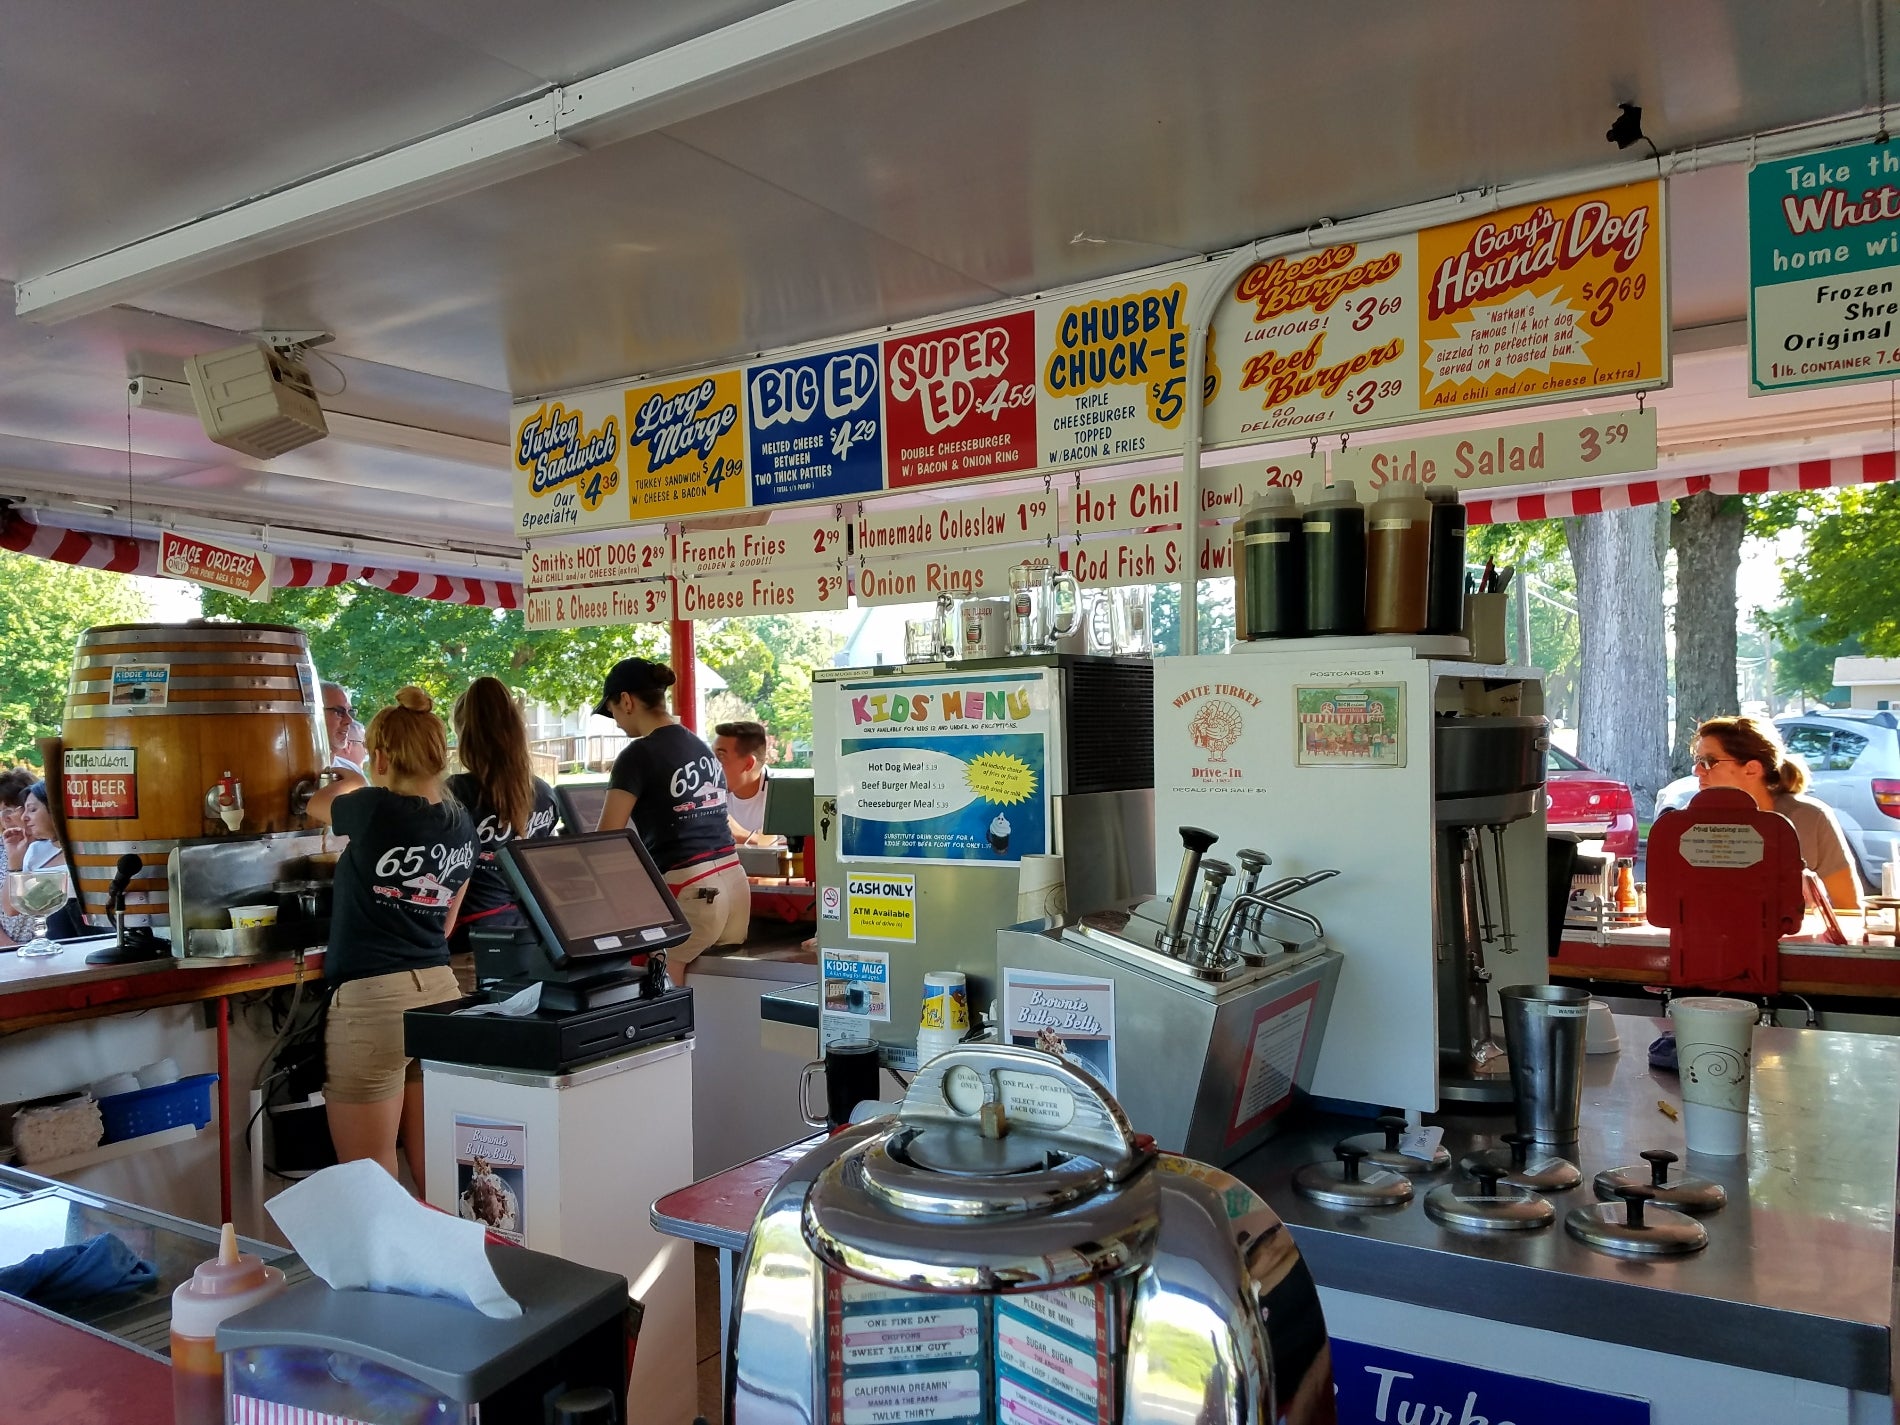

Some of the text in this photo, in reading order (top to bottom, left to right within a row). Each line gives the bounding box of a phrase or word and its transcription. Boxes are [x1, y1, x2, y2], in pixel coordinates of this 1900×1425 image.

[1786, 163, 1850, 191] Take
[1783, 189, 1900, 234] Whit
[1473, 208, 1553, 258] Gary's
[1433, 202, 1649, 315] Hound Dog
[1774, 246, 1849, 271] home
[1238, 244, 1356, 300] Cheese
[1256, 253, 1401, 320] Burgers
[1817, 281, 1893, 303] Frozen
[1062, 290, 1180, 348] CHUBBY
[1844, 302, 1898, 321] Shre
[1244, 317, 1329, 343] LUCIOUS!
[1471, 314, 1573, 341] Famous 1/4 hot dog
[1784, 322, 1890, 351] Original
[1437, 334, 1548, 362] sizzled perfection
[890, 327, 1010, 401] SUPER
[1050, 333, 1185, 389] CHUCK-E
[1242, 333, 1325, 389] Beef
[1265, 339, 1402, 408] Burgers
[1440, 349, 1547, 376] served toasted
[1801, 356, 1870, 375] CONTAINER
[751, 353, 878, 430] BIG ED
[1434, 362, 1641, 405] Add chili and/or cheese (extra)
[634, 380, 715, 441] Large
[920, 380, 974, 434] ED
[1076, 393, 1109, 410] TRIPLE
[1054, 406, 1135, 430] CHEESEBURGER
[1241, 411, 1334, 432] DELICIOUS!
[521, 408, 578, 461] Turkey
[651, 405, 736, 467] Marge
[762, 435, 823, 455] MELTED CHEESE
[901, 434, 1011, 460] DOUBLE CHEESEBURGER
[1075, 427, 1112, 444] TOPPED
[1116, 438, 1145, 453] FRIES
[534, 423, 616, 488] Sandwich
[774, 453, 810, 468] BETWEEN
[918, 450, 1019, 475] BACON ONION RING
[1369, 451, 1437, 489] Side
[1454, 433, 1545, 479] Salad
[636, 472, 700, 489] TURKEY SANDWICH
[755, 465, 832, 486] TWO THICK PATTIES
[554, 493, 575, 506] Our
[644, 487, 707, 503] CHEESE BACON
[1076, 481, 1243, 524] Hot Chil (Bowl)
[859, 515, 932, 549] Homemade
[939, 507, 1005, 541] Coleslaw
[168, 541, 254, 577] PLACE ORDERS
[532, 553, 574, 573] Smith's
[577, 545, 602, 569] HOT
[608, 543, 636, 565] DOG
[682, 537, 736, 563] French
[744, 535, 786, 556] Fries
[531, 566, 640, 584] Add CHILI and/or CHEESE (extra)
[697, 557, 772, 571] GOLDEN GOOD!!!
[1076, 544, 1155, 582] Cod Fish
[861, 563, 984, 598] Onion Rings
[527, 590, 639, 624] Chili Cheese Fries
[685, 584, 743, 611] Cheese
[752, 579, 795, 606] Fries
[852, 688, 1031, 725] KIDS' MENU
[1173, 684, 1262, 708] WHITE TURKEY
[65, 754, 128, 768] RICHardson
[868, 762, 924, 773] Hot Dog Meal
[67, 781, 126, 795] ROOT BEER
[670, 761, 699, 797] 65
[862, 781, 931, 792] Beef Burger Meal
[858, 799, 935, 810] Cheeseburger Meal
[376, 841, 473, 884] 65 Years
[849, 882, 913, 897] CASH ONLY
[853, 907, 910, 919] ATM Available
[862, 964, 883, 975] MUG
[1030, 990, 1088, 1012] Brownie
[1063, 1012, 1101, 1035] Belly
[1017, 1081, 1033, 1090] PLAY
[1010, 1104, 1060, 1118] EACH QUARTER
[1011, 1097, 1058, 1109] SELECT AFTER
[473, 1129, 508, 1146] Brownie
[493, 1148, 516, 1164] Belly
[1023, 1297, 1045, 1314] PLEASE
[1052, 1349, 1073, 1367] SUGAR
[855, 1384, 905, 1396] CALIFORNIA
[905, 1408, 935, 1419] THIRTY
